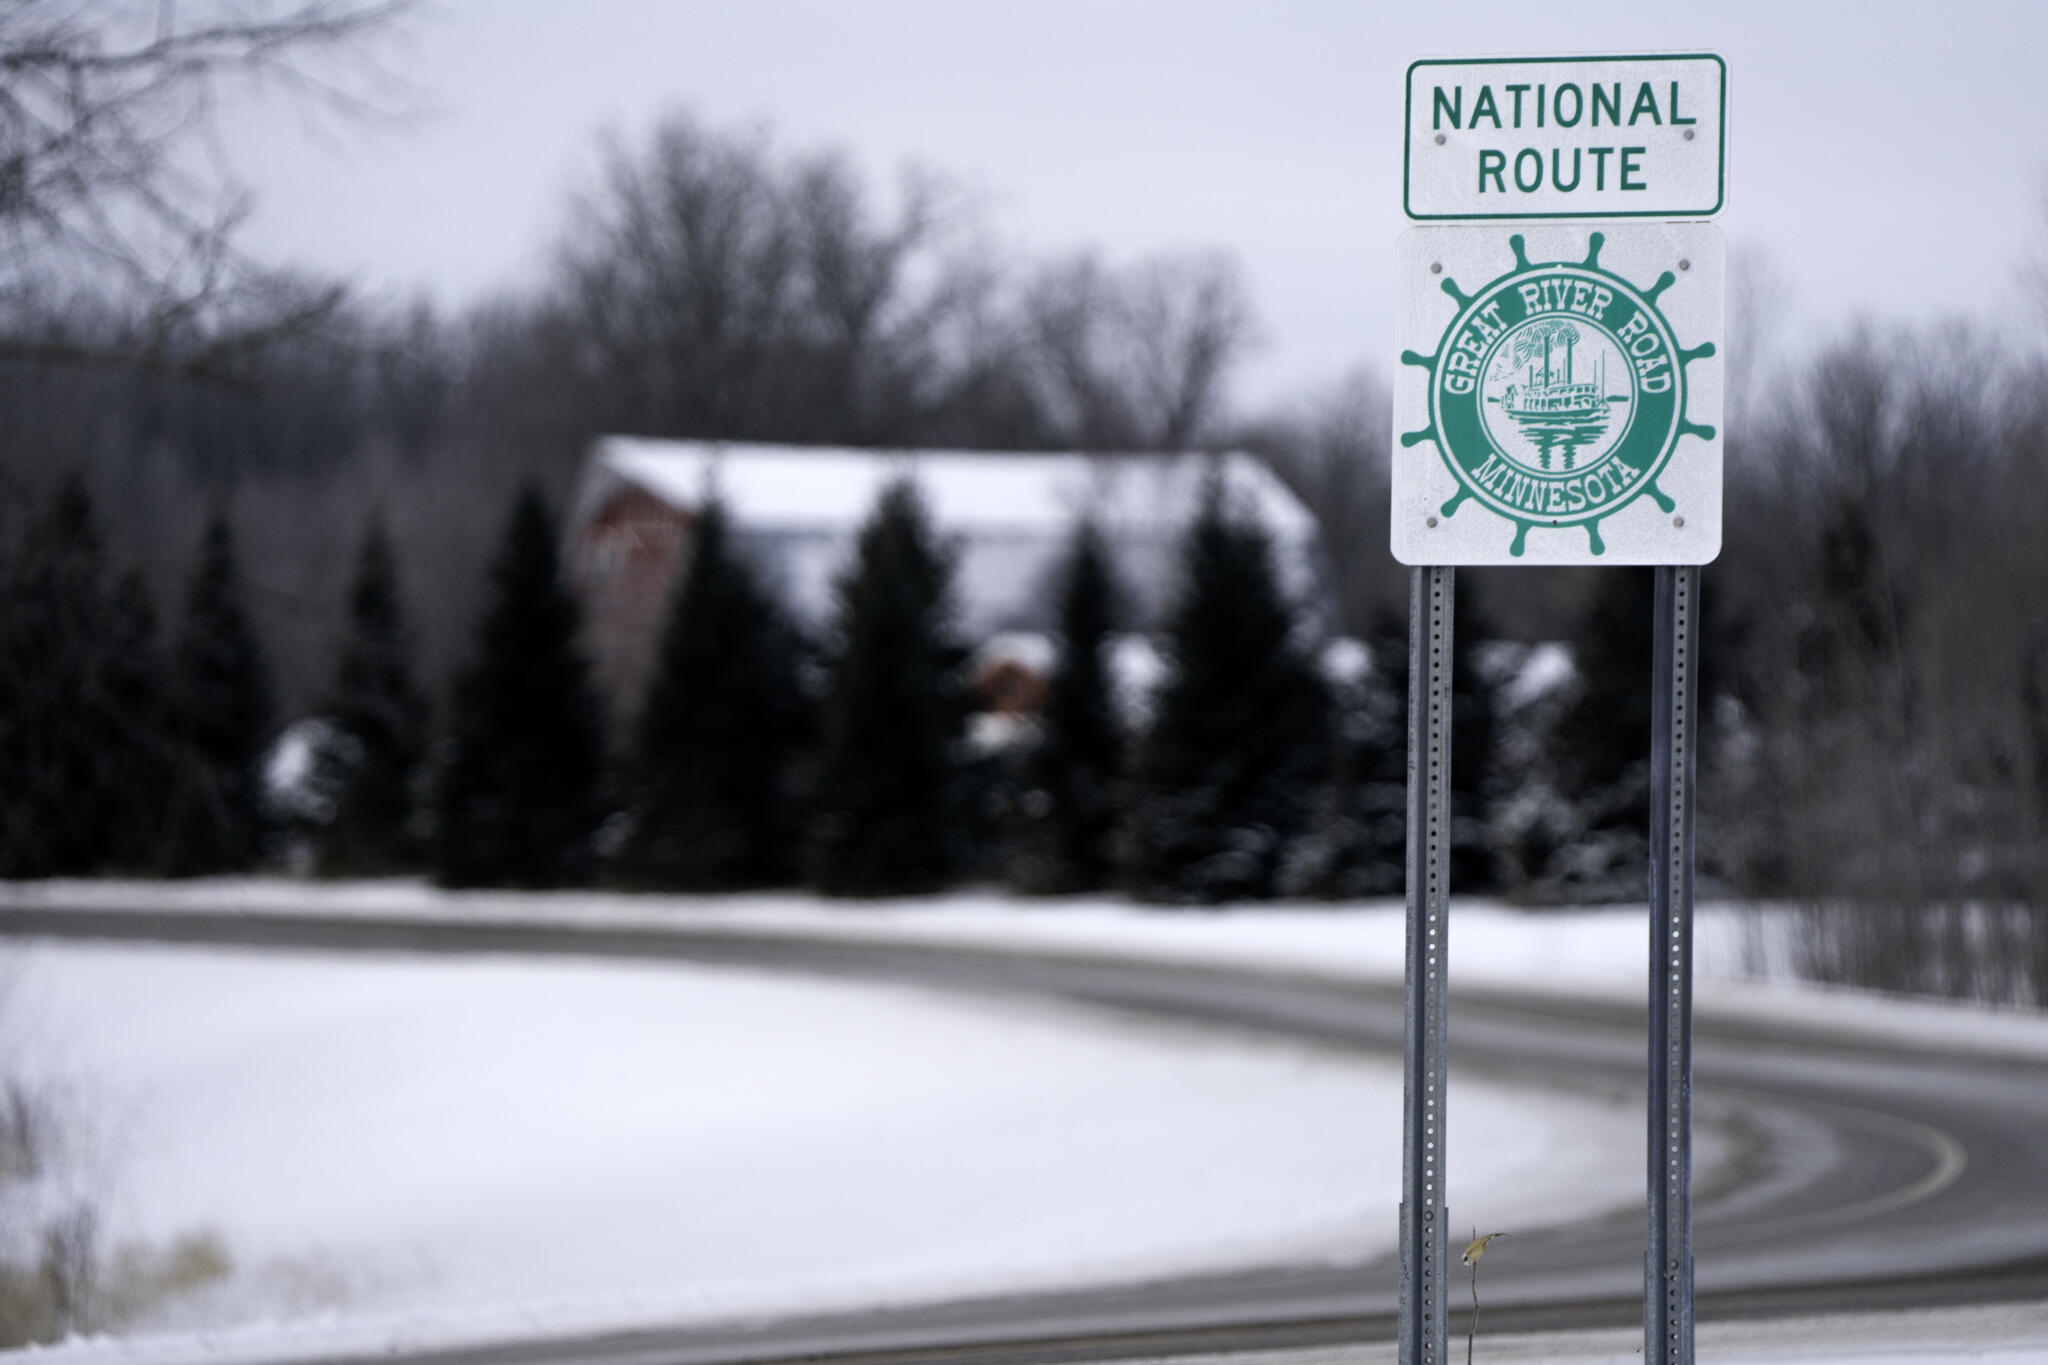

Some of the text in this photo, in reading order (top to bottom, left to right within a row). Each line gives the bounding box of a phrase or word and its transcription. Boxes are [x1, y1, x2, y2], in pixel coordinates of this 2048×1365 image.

[1433, 81, 1697, 130] NATIONAL
[1478, 146, 1647, 193] ROUTE
[1444, 278, 1672, 394] GREAT RIVER ROAD
[1471, 453, 1641, 513] MINNESOTA
